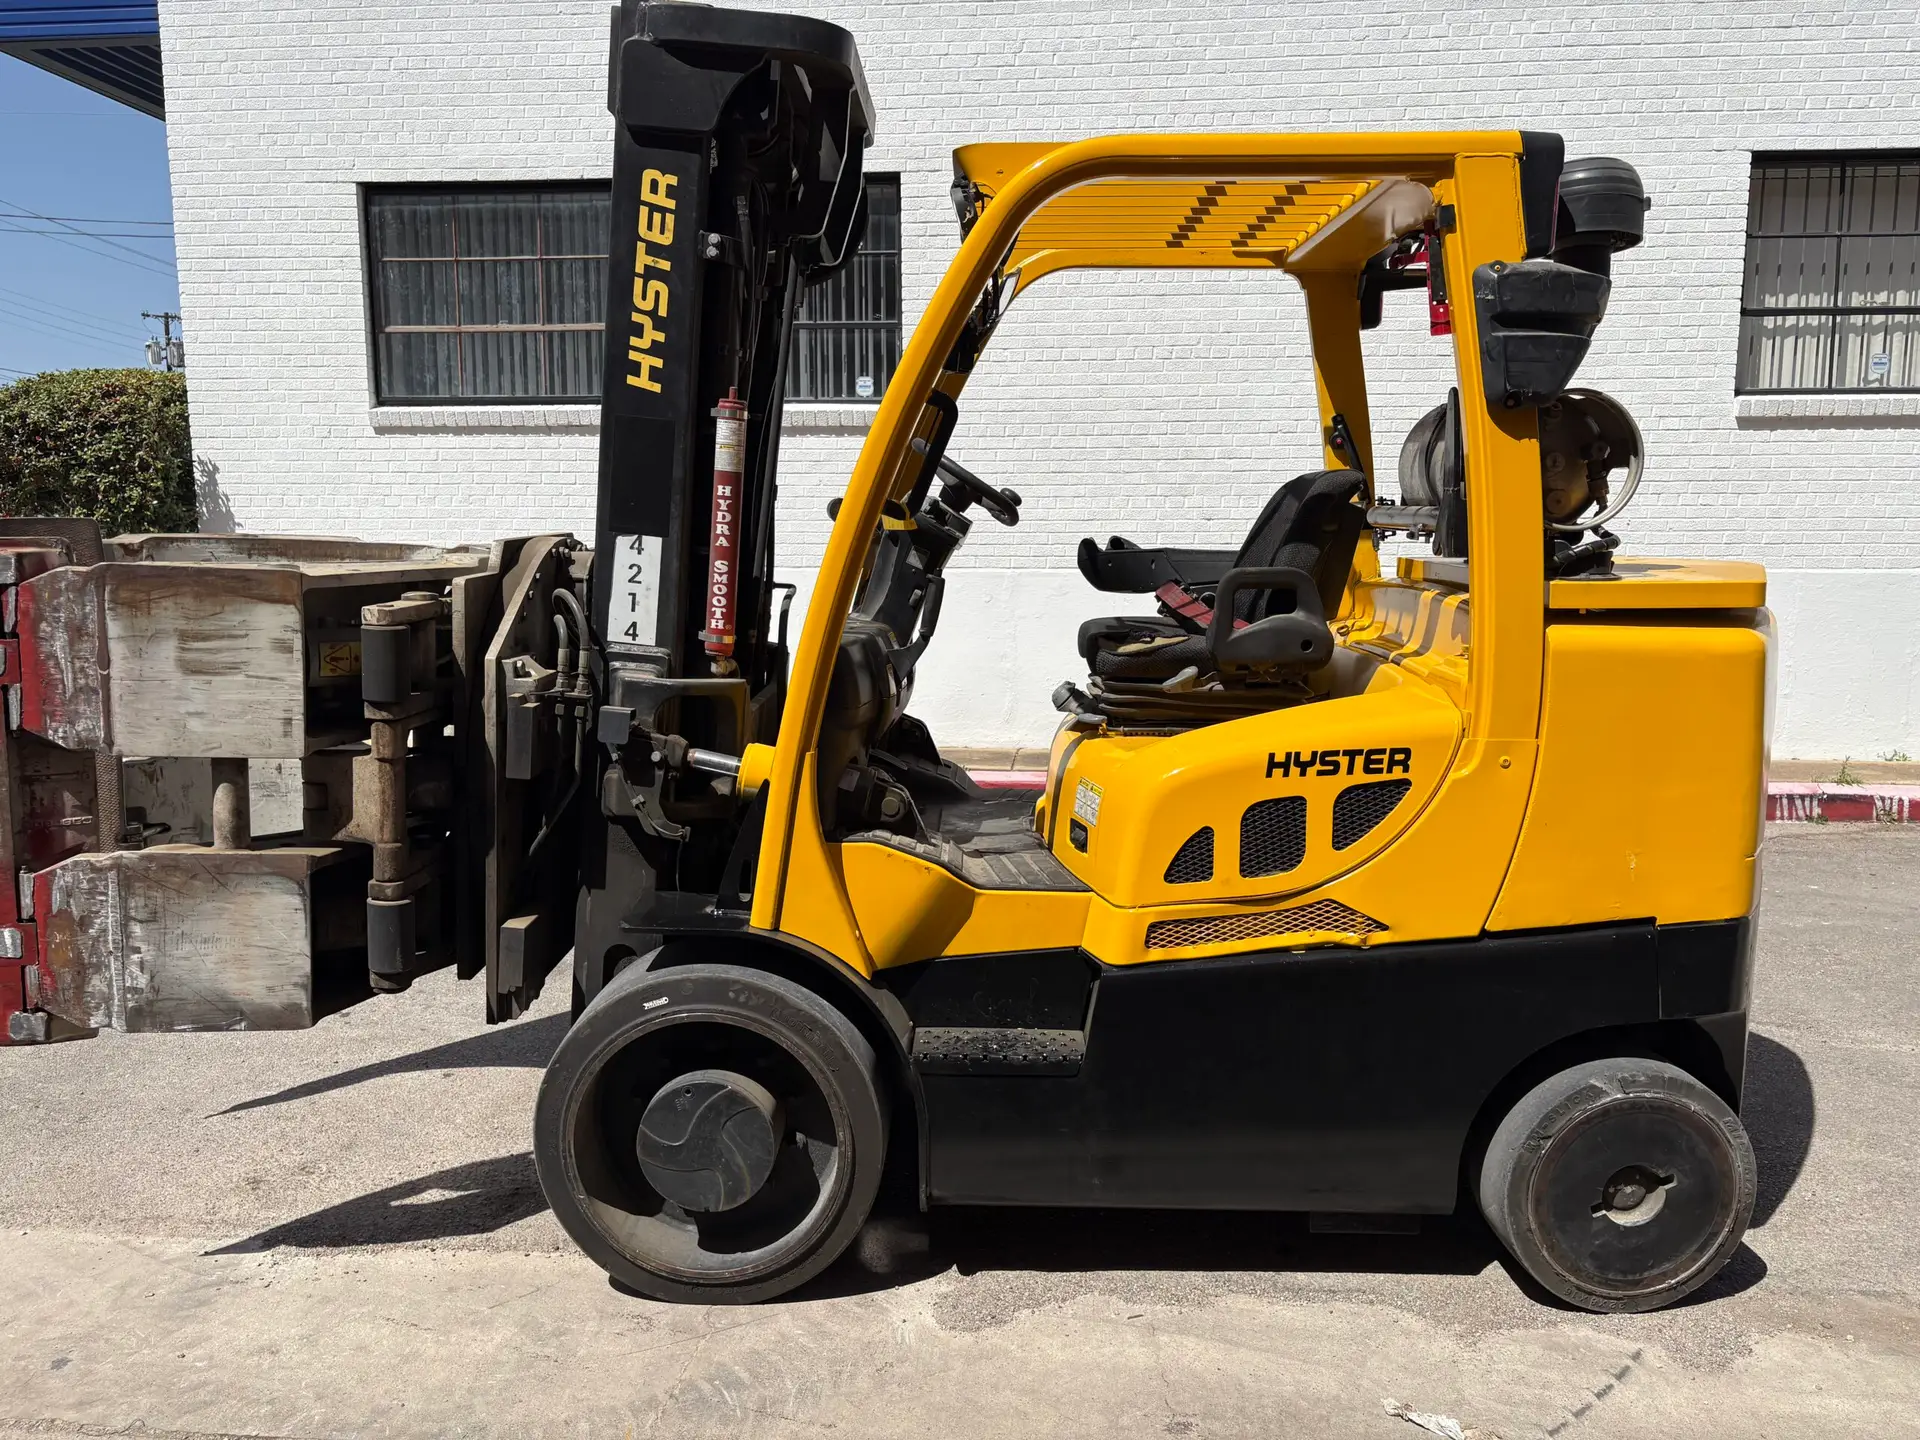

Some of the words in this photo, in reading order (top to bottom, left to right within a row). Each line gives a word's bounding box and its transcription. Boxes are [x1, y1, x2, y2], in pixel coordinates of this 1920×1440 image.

[626, 168, 679, 394] HYSTER
[714, 484, 733, 547] HYDRA
[709, 559, 729, 630] SMOOTH
[1265, 747, 1413, 779] HYSTER
